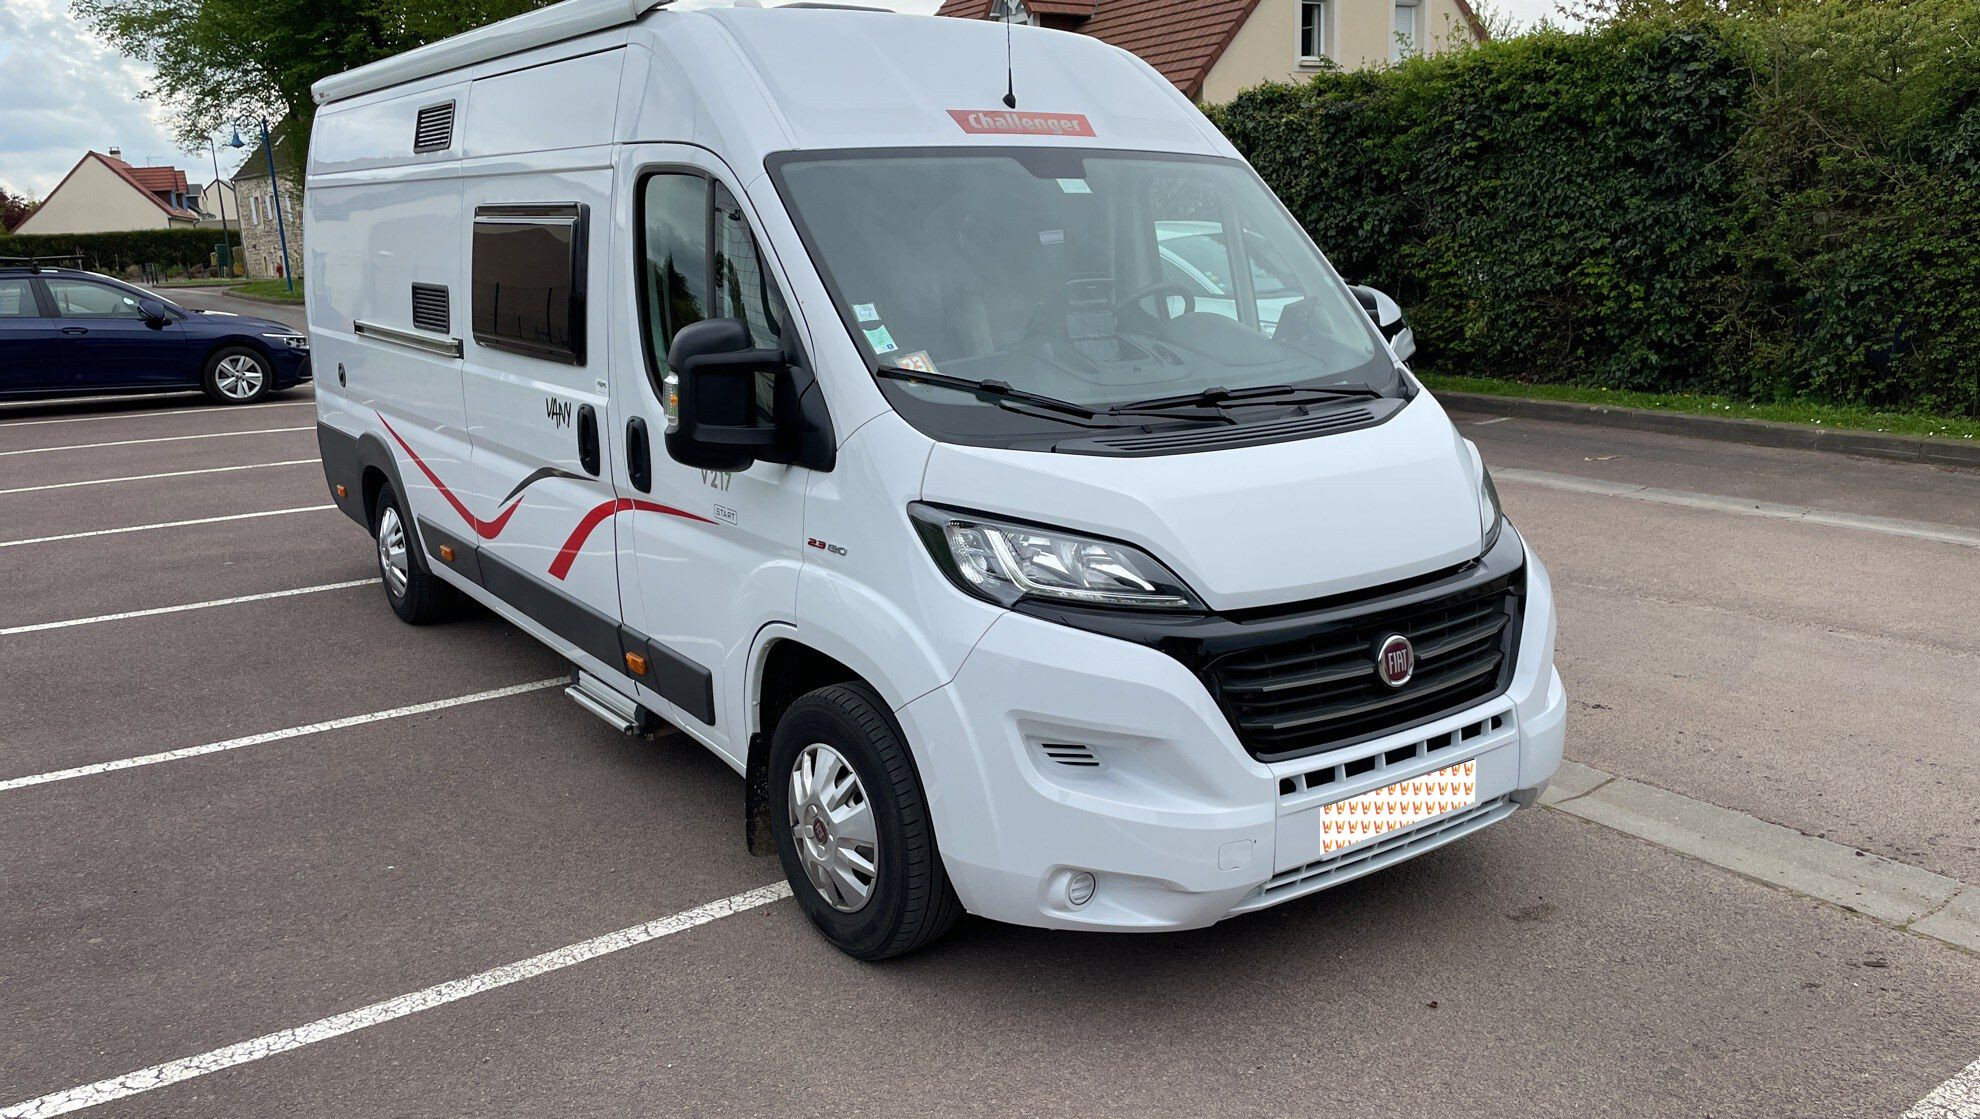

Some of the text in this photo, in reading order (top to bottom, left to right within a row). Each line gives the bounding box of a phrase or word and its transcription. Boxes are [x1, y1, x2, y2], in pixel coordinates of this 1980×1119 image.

[967, 112, 1081, 134] Challenger
[545, 397, 571, 429] VANY
[715, 507, 736, 521] START
[1387, 649, 1407, 675] FIAT
